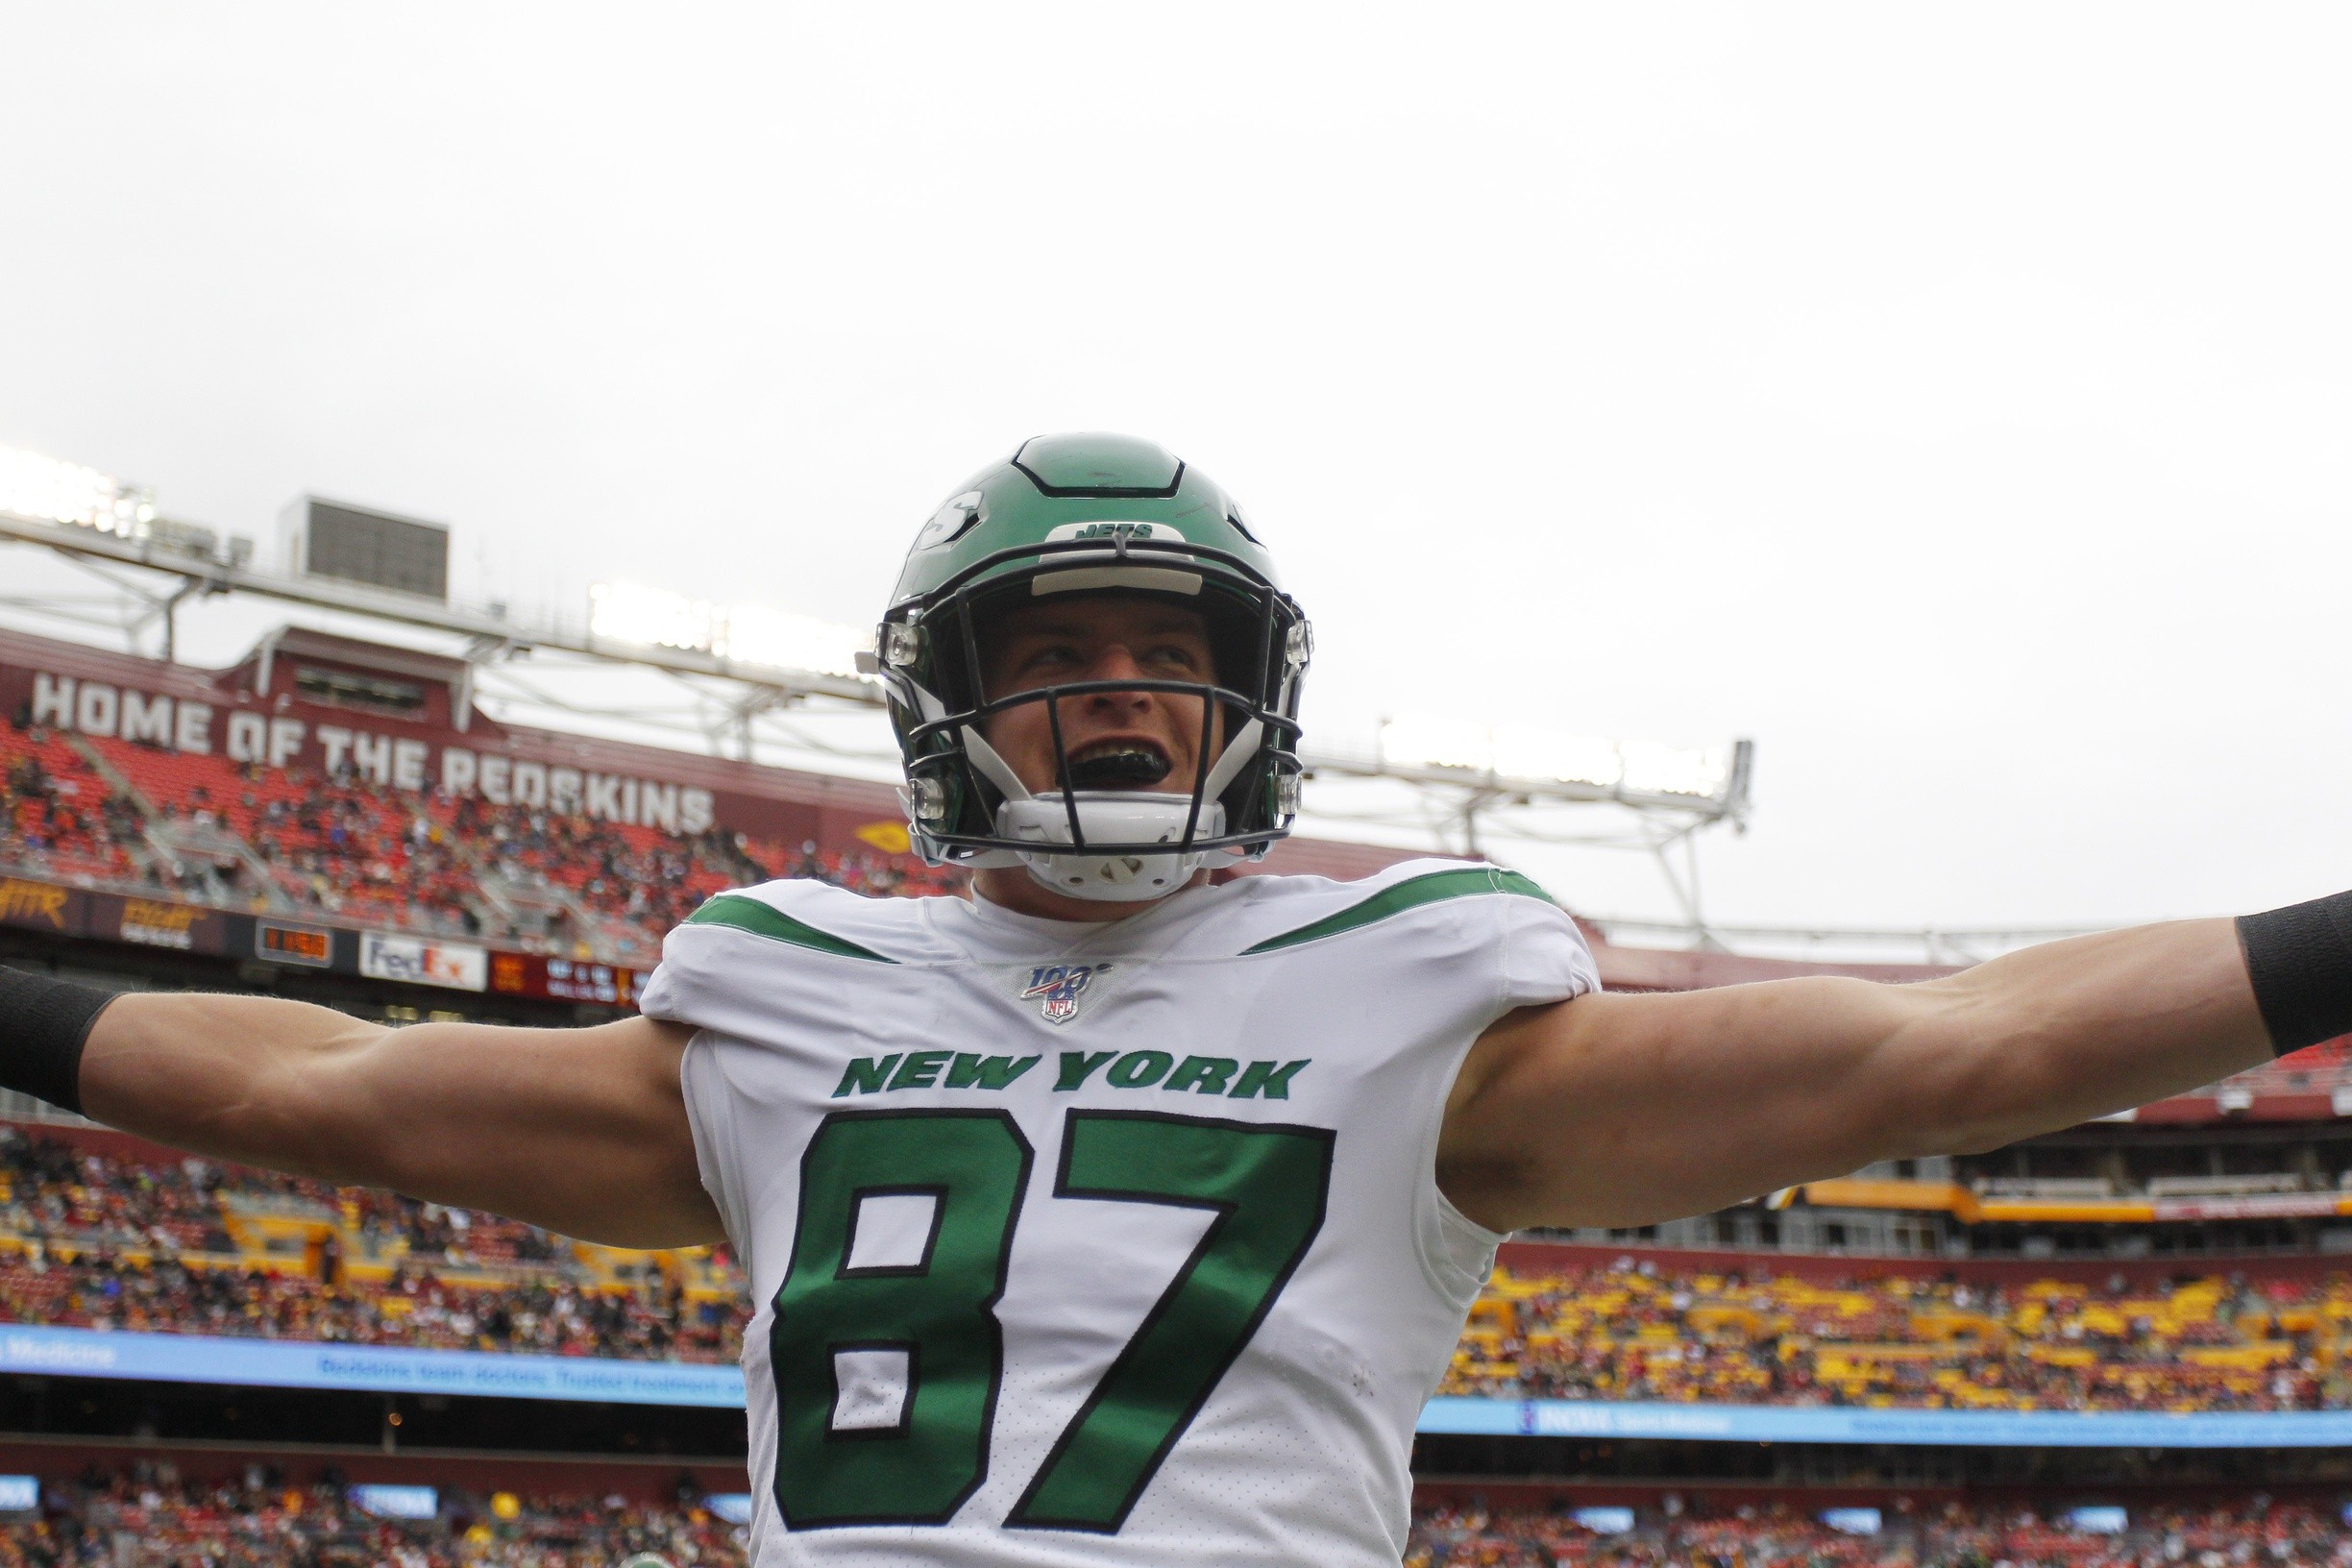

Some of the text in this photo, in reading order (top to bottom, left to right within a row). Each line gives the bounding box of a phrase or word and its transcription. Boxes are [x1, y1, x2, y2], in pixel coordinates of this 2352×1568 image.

[1075, 524, 1153, 539] JETS
[32, 673, 713, 835] HOME OF THE REDSKINS
[368, 936, 469, 986] FedEx
[1048, 1000, 1072, 1015] NFL
[831, 1050, 1312, 1100] NEW YORK
[770, 1107, 1337, 1535] 87
